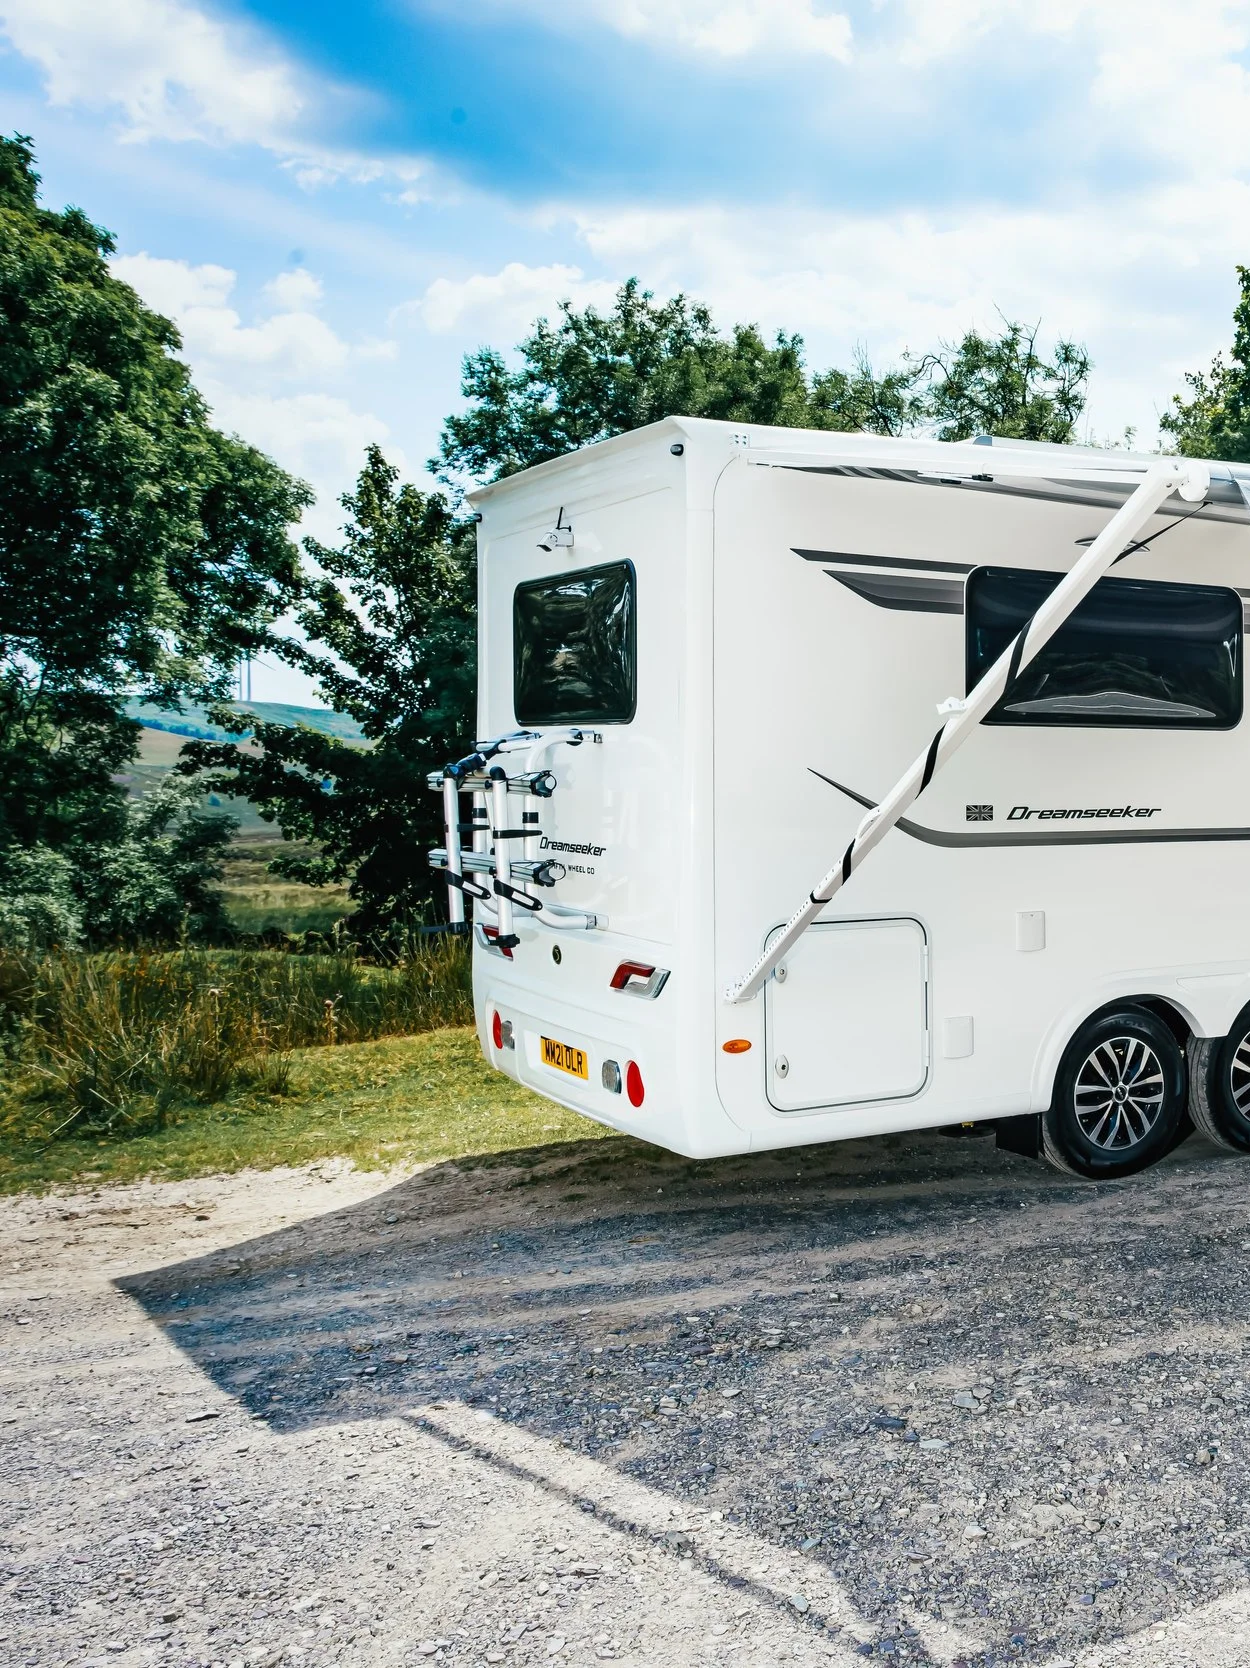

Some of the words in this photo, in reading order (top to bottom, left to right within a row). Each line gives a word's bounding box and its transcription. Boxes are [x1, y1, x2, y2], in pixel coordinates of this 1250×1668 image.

[1007, 806, 1162, 820] Dreamseeker
[539, 836, 607, 857] Dreamseeker
[568, 865, 586, 873] WHEEL
[587, 867, 595, 875] CO
